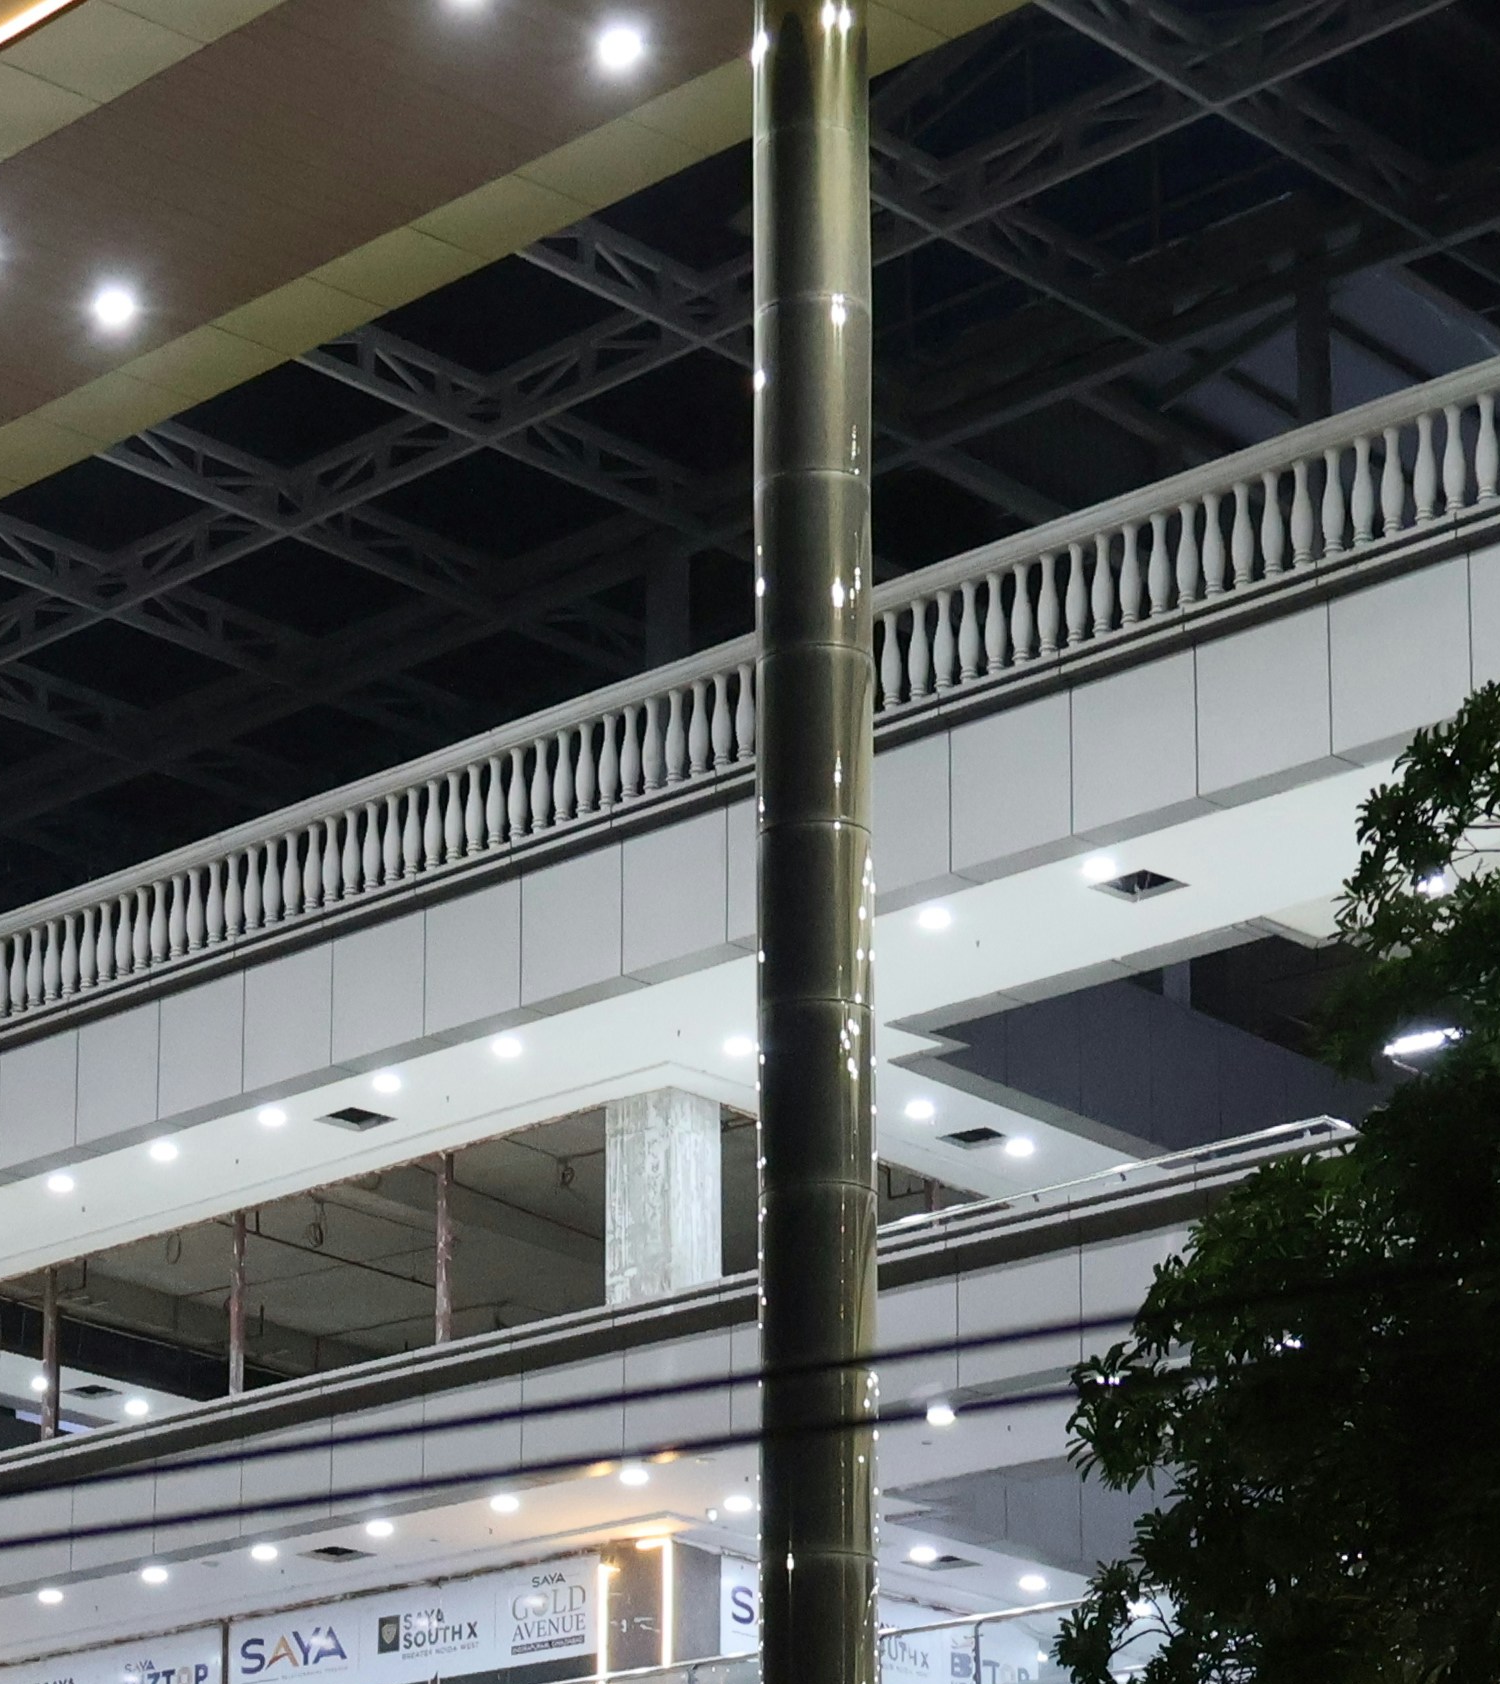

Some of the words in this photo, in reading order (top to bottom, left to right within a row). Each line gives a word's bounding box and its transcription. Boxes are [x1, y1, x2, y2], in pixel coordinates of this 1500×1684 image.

[531, 1572, 566, 1588] SAYA
[403, 1623, 463, 1649] SOUTH
[466, 1620, 478, 1640] X
[512, 1612, 586, 1642] AVENUE
[240, 1626, 348, 1675] SAYA
